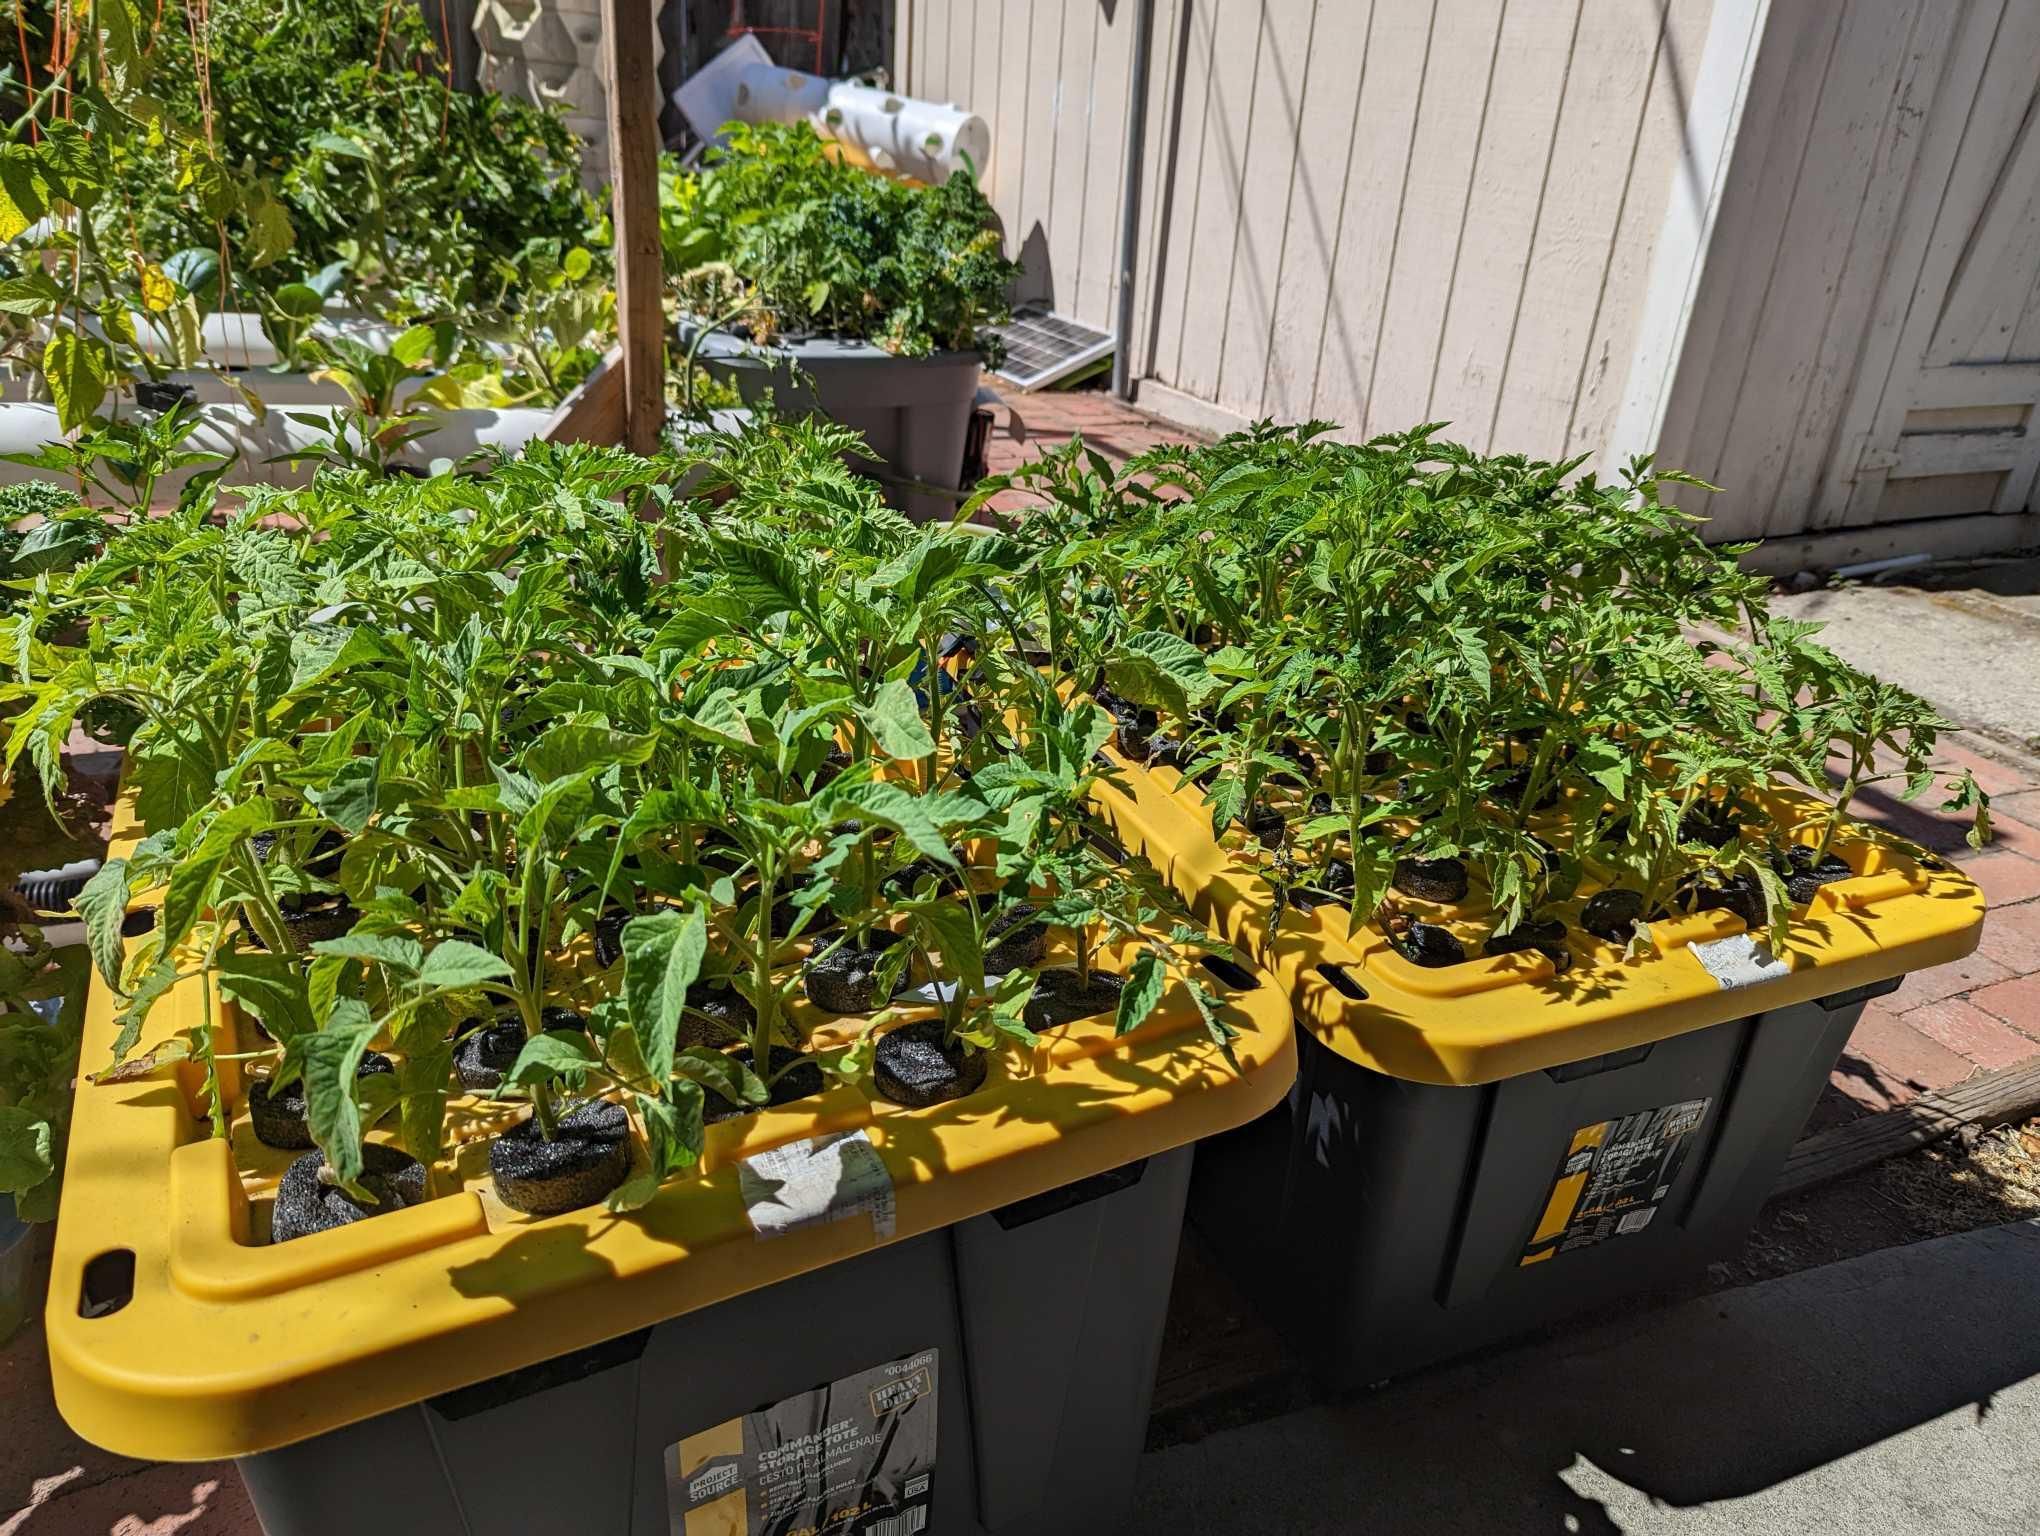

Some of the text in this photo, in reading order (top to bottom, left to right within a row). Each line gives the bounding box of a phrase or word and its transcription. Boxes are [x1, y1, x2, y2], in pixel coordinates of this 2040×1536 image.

[876, 1374, 922, 1399] HEAVY
[758, 1426, 860, 1472] STORAGE TOTE
[796, 1458, 811, 1474] DE
[690, 1477, 738, 1502] SOURCE
[692, 1468, 735, 1489] PROJECT
[907, 1485, 926, 1496] USA
